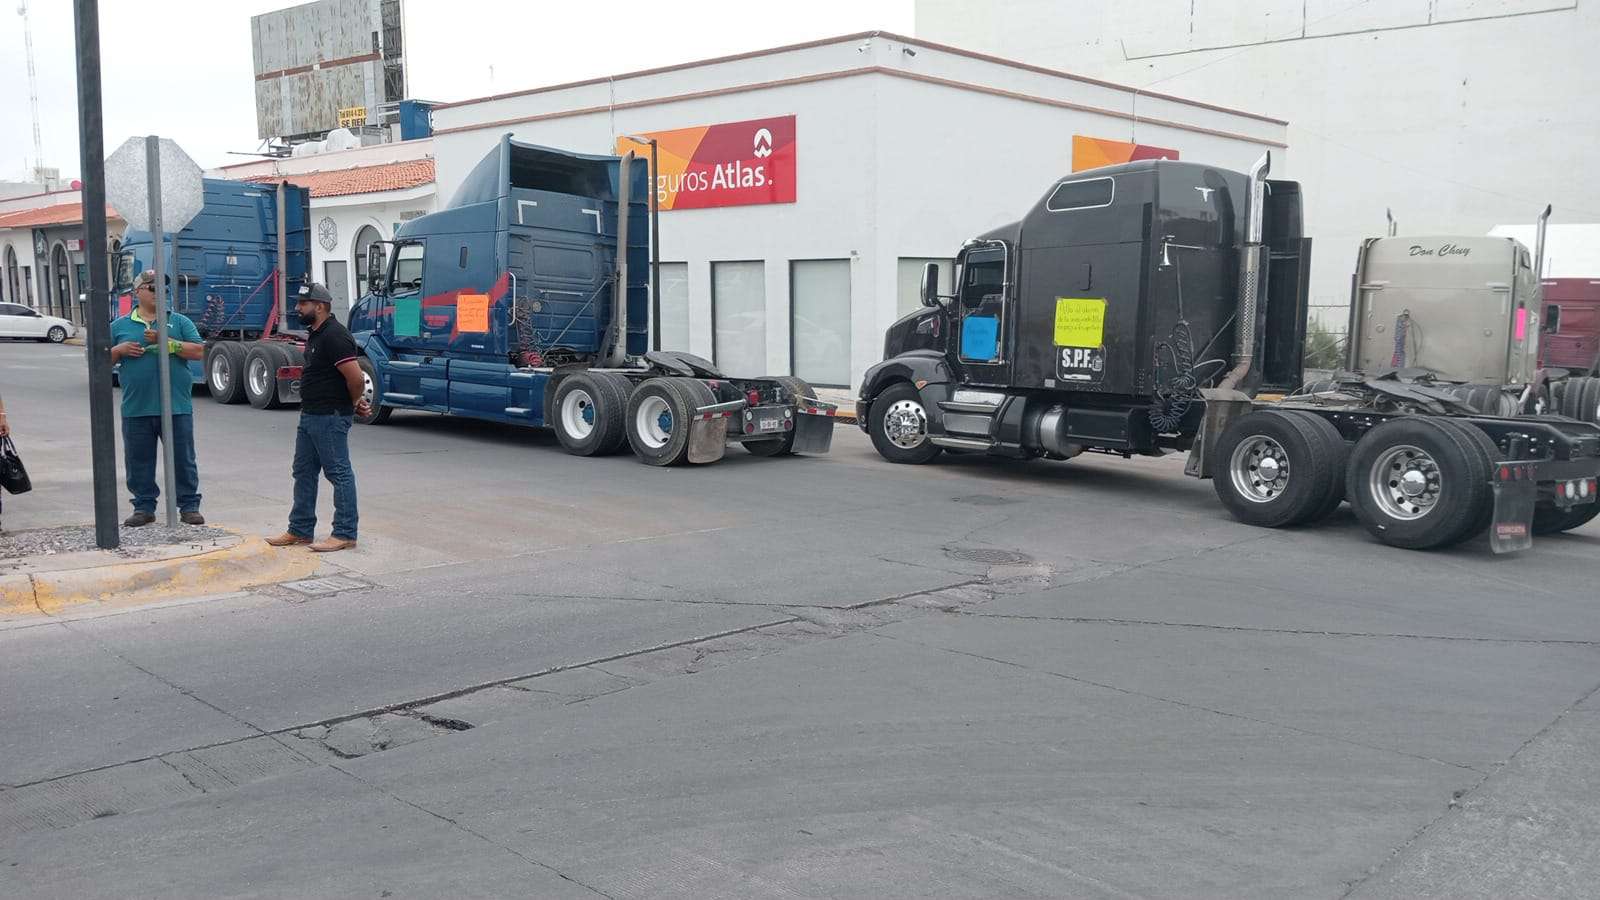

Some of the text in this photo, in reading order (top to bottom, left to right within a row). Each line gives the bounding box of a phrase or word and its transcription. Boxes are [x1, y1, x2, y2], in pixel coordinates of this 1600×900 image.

[341, 119, 351, 128] SE
[648, 170, 707, 202] guros
[1409, 244, 1471, 257] Don Chuy
[1062, 348, 1092, 368] S.P.F.
